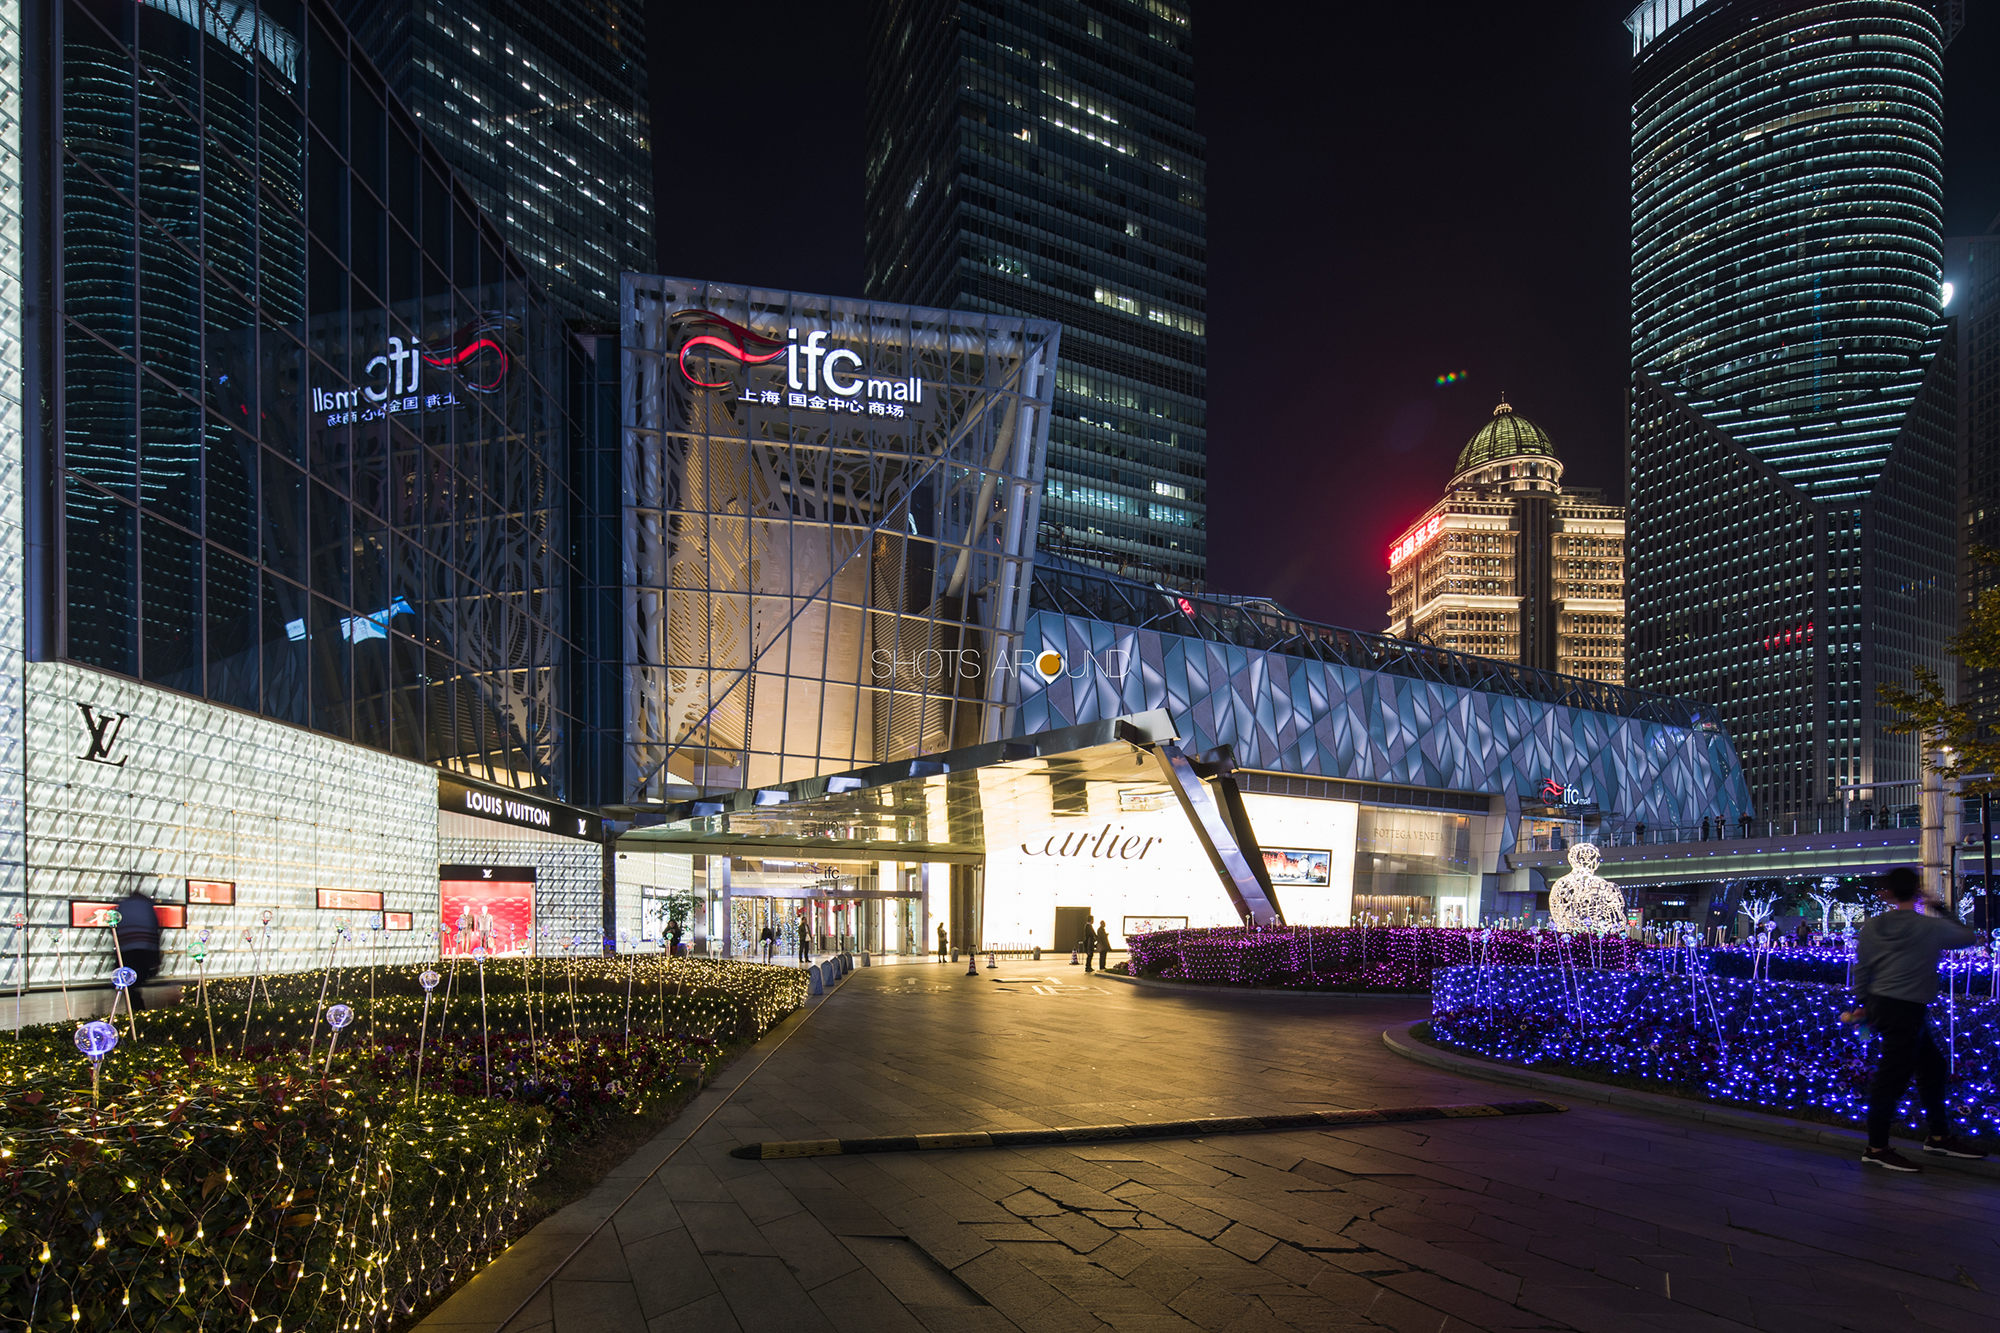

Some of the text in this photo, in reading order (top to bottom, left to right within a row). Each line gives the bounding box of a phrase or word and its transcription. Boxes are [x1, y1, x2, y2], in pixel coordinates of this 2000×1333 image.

[787, 327, 922, 403] ifc mall
[1391, 515, 1440, 566] 中国平安
[1563, 783, 1579, 804] ifc
[466, 791, 550, 827] LOUIS VUITTON
[1373, 828, 1445, 842] BOTTEGA VENETA
[824, 866, 840, 879] ifc
